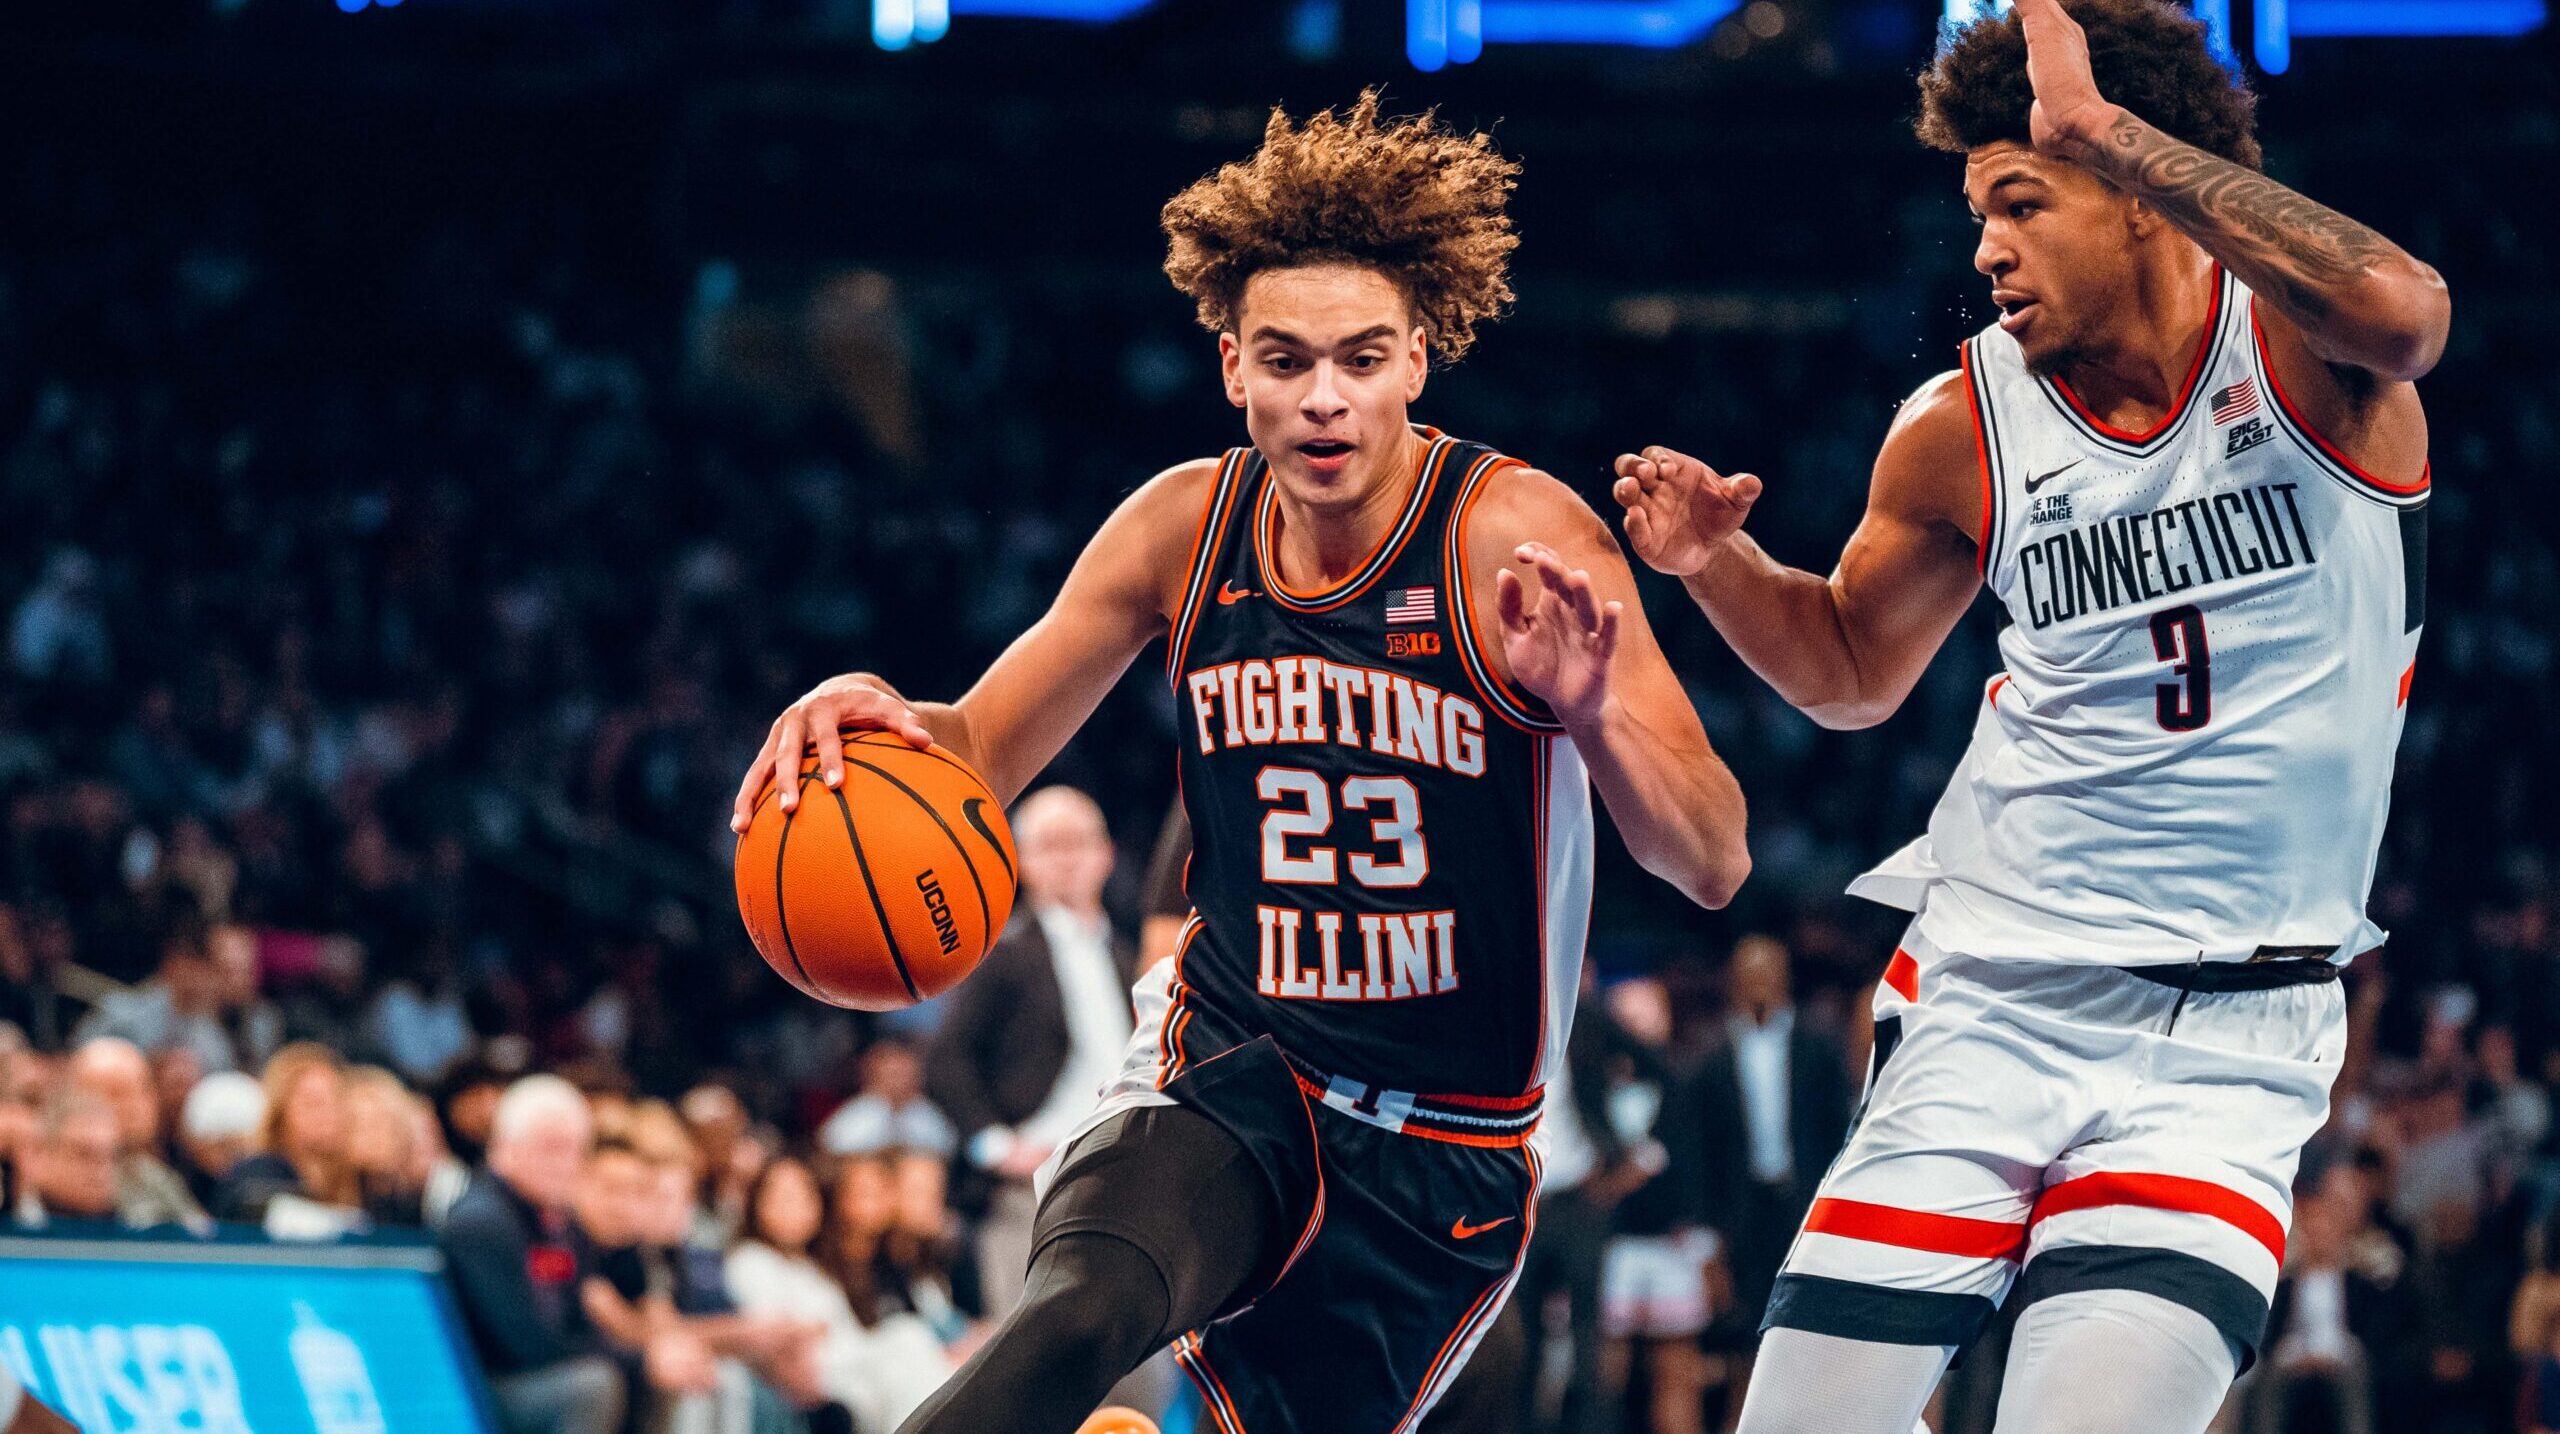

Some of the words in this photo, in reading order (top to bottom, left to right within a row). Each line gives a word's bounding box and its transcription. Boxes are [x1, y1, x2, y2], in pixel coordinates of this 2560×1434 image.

[2226, 423, 2275, 454] EAST
[2228, 416, 2261, 441] BIG
[2045, 493, 2070, 509] THE
[2019, 482, 2316, 631] CONNECTICUT
[2149, 604, 2211, 732] 3
[1188, 657, 1487, 778] FIGHTING
[1256, 766, 1430, 888] 23
[915, 868, 961, 956] UCONN
[1257, 904, 1460, 1001] ILLINI
